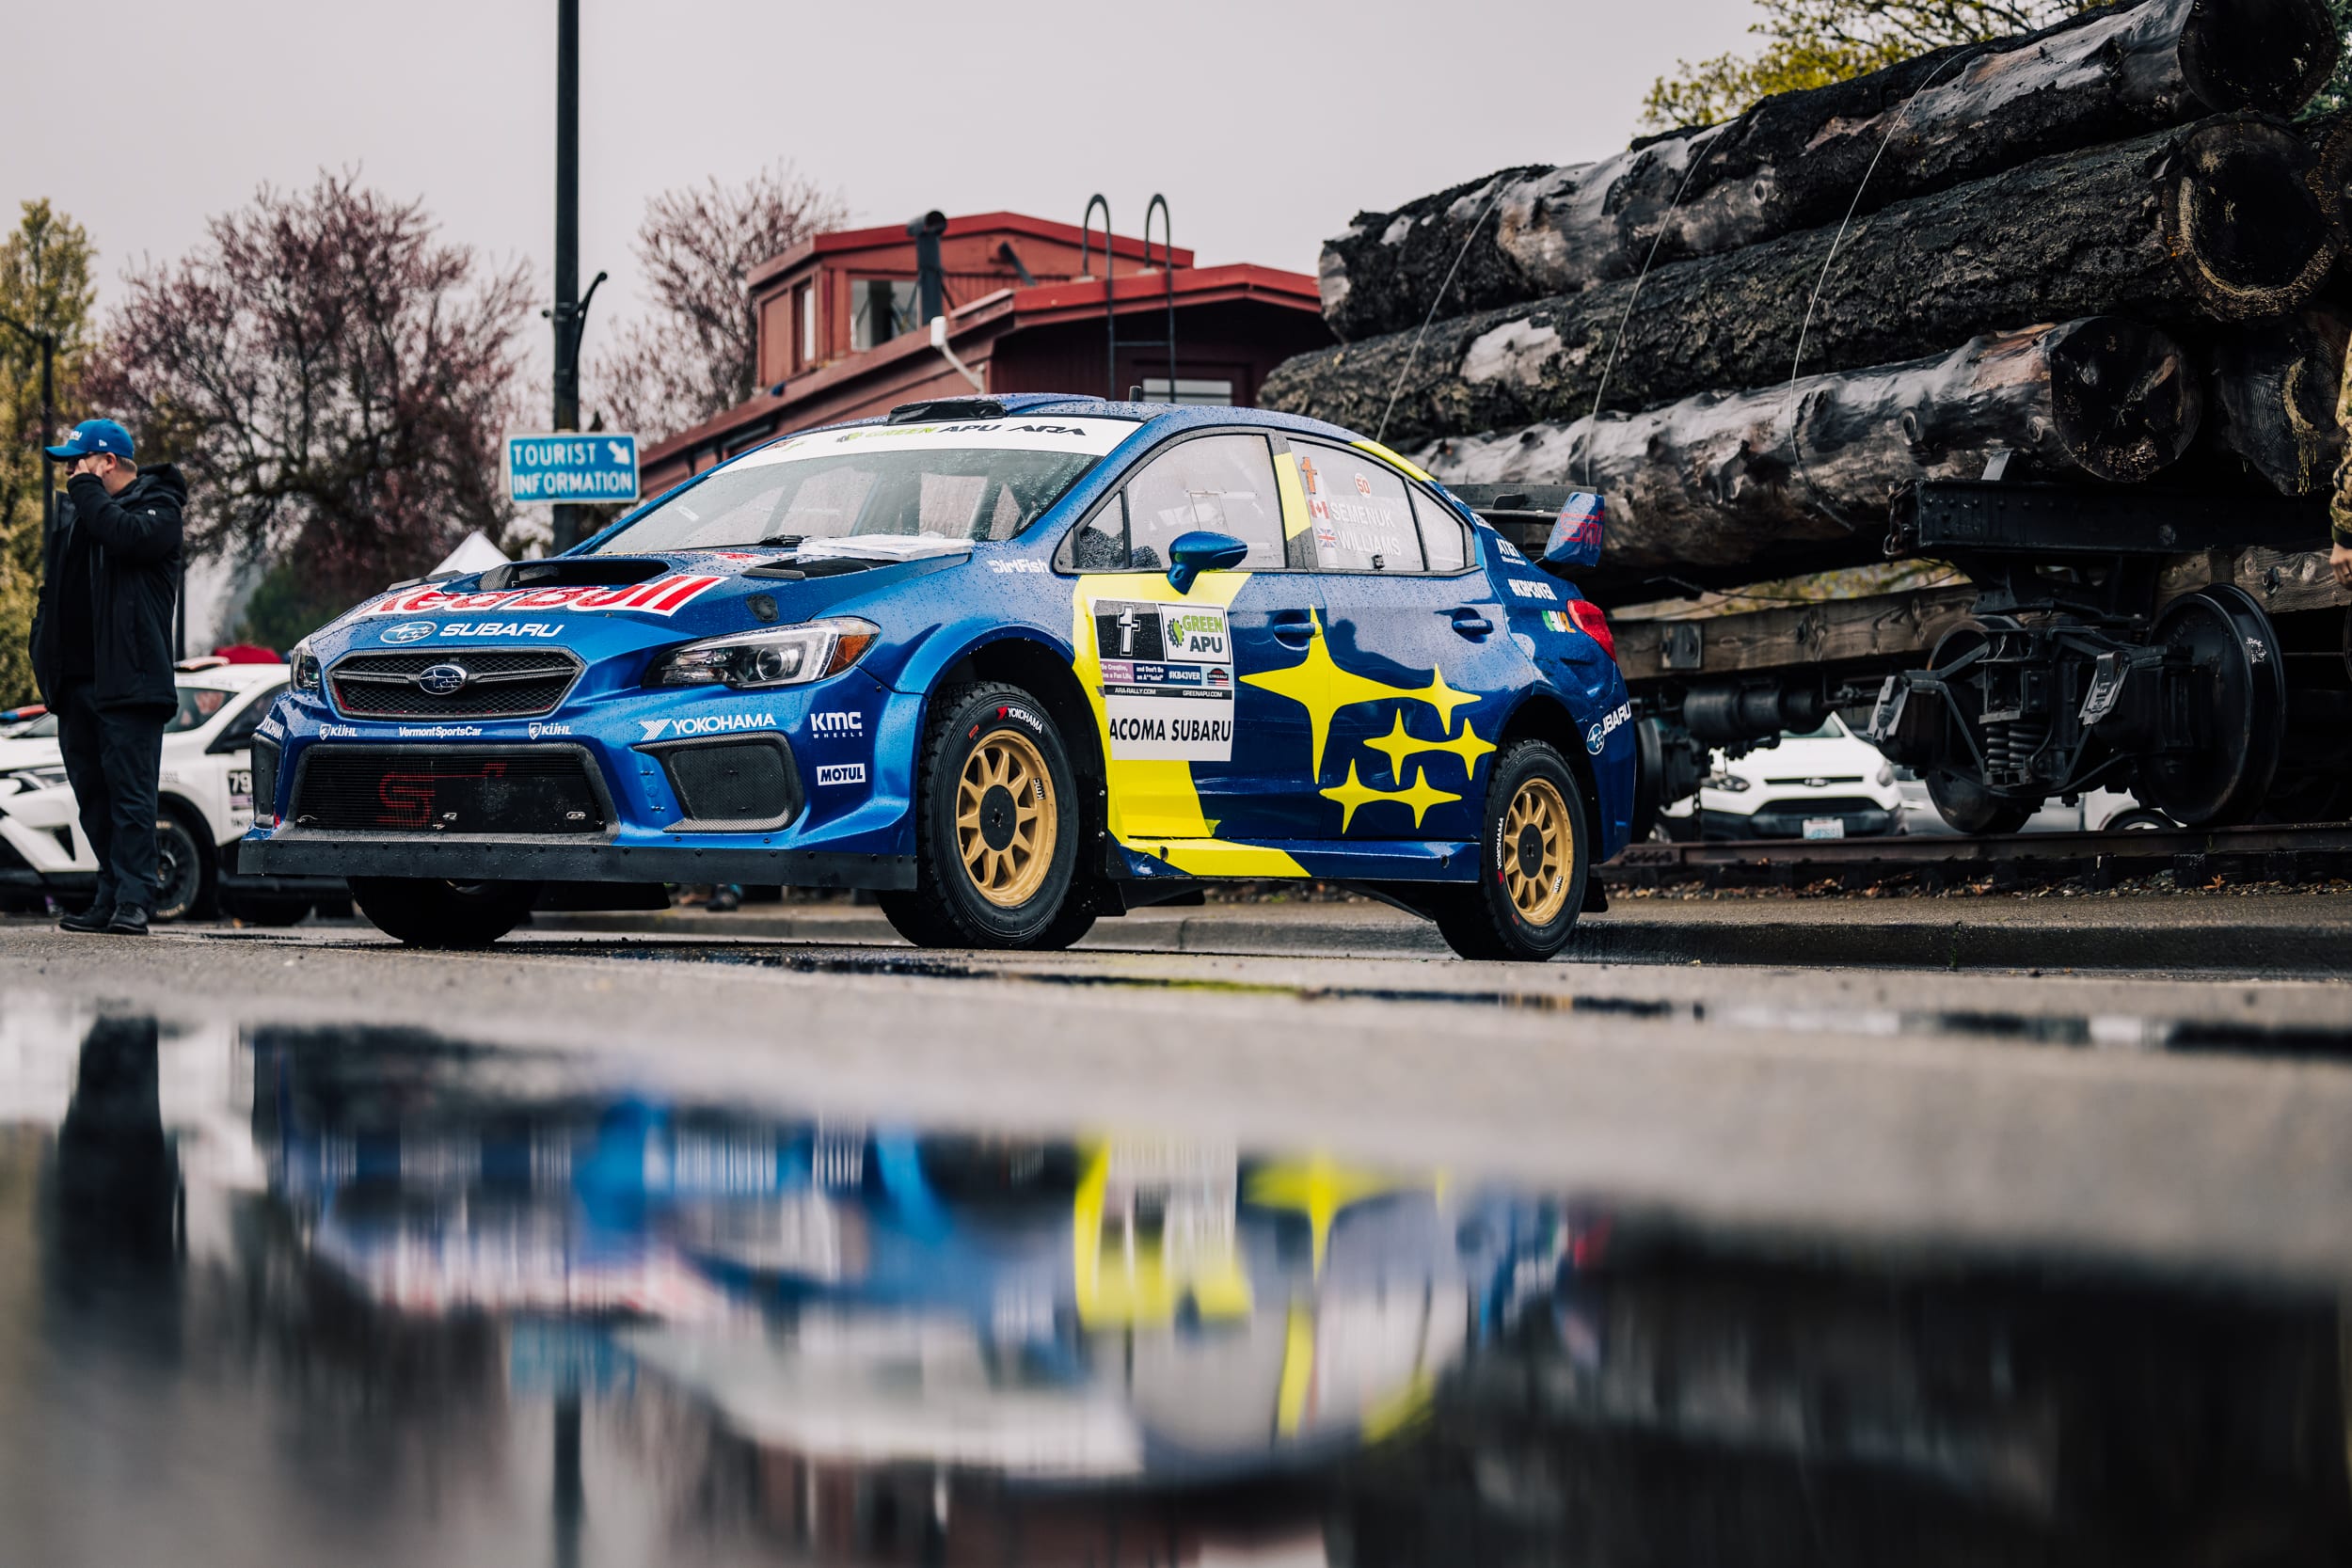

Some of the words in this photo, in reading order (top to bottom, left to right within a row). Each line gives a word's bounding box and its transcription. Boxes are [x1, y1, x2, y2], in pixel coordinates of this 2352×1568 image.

[938, 424, 1003, 433] APU
[514, 443, 596, 467] TOURIST
[514, 471, 633, 494] INFORMATION
[1356, 478, 1371, 494] 50
[1329, 501, 1394, 528] SEMENUK
[1337, 530, 1402, 557] WILLIAMS
[439, 622, 564, 638] SUBARU
[1182, 614, 1224, 633] GREEN
[1189, 635, 1223, 654] APU
[671, 713, 777, 735] YOKOHAMA
[1008, 707, 1043, 734] YOKOHAMA
[1602, 701, 1631, 736] BARU
[398, 726, 483, 738] VermontSportsCar
[541, 722, 571, 736] KÜHL
[812, 731, 864, 739] WHEELS
[1109, 718, 1166, 740] ACOMA
[1171, 720, 1232, 742] SUBARU
[819, 767, 864, 783] MOTUL
